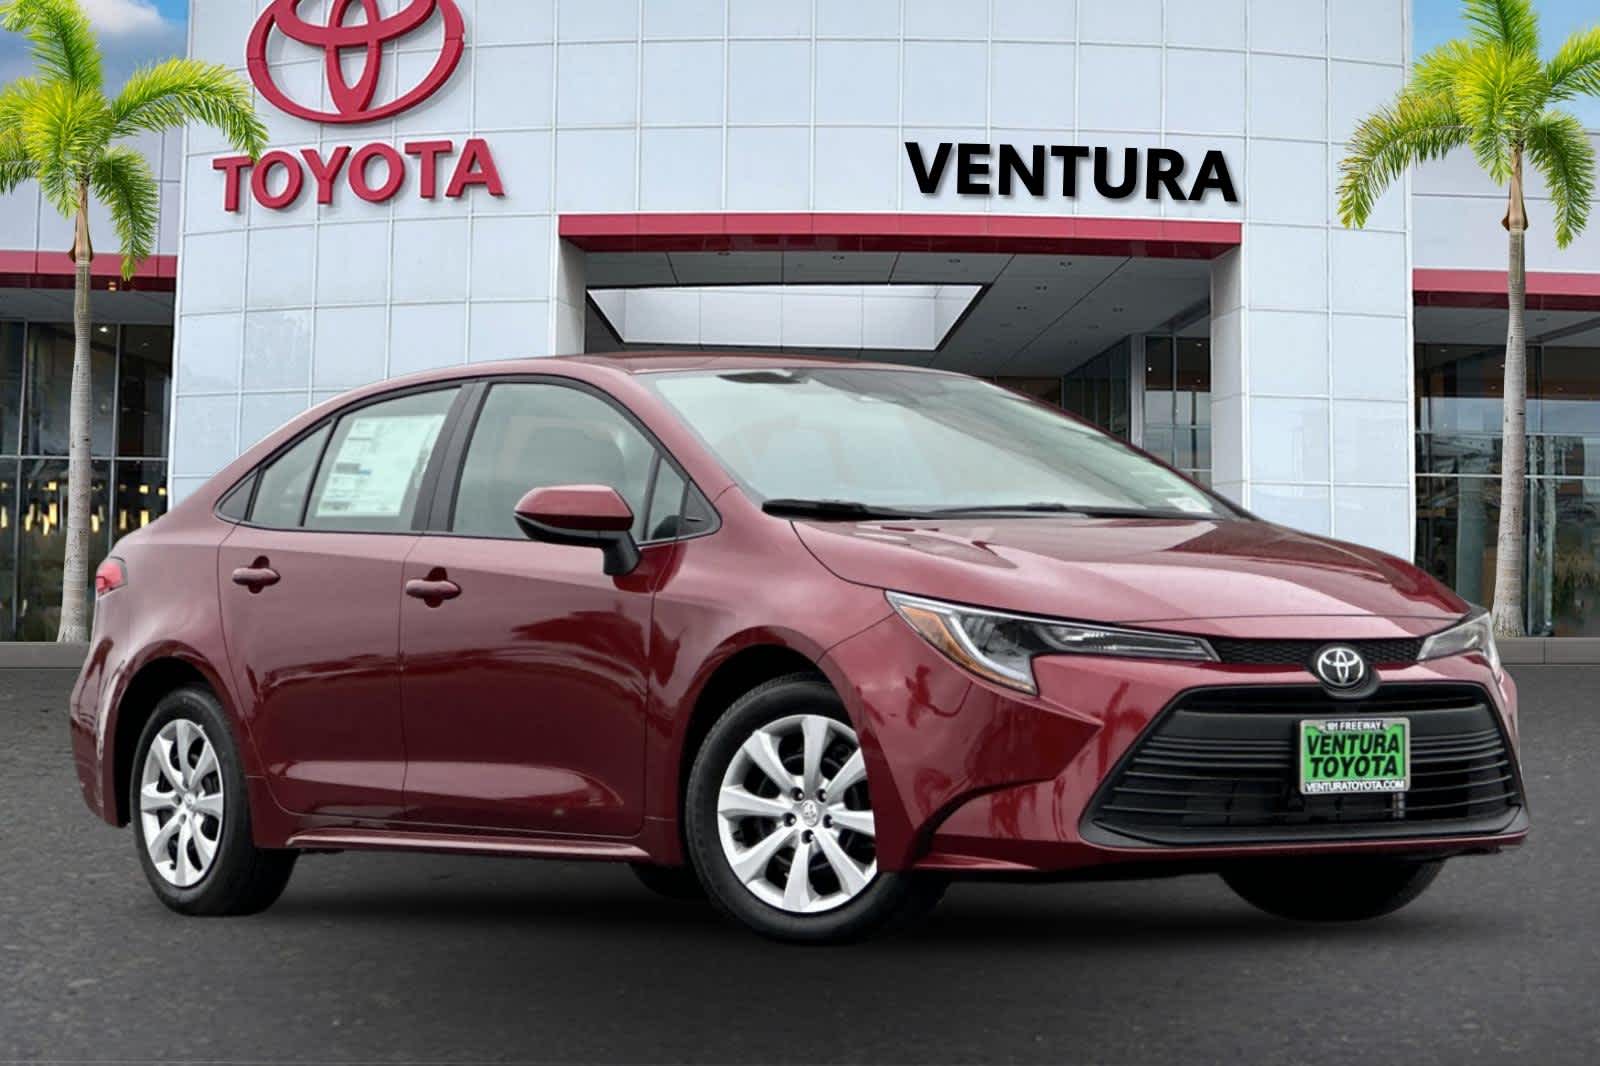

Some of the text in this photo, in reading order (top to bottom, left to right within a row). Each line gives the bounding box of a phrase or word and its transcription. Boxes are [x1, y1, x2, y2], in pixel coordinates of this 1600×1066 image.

[212, 138, 505, 212] TOYOTA
[904, 141, 1239, 203] VENTURA
[1307, 733, 1400, 755] VENTURA
[1310, 755, 1398, 778] TOYOTA
[1305, 780, 1405, 792] VENTURATOYOTA.COM
